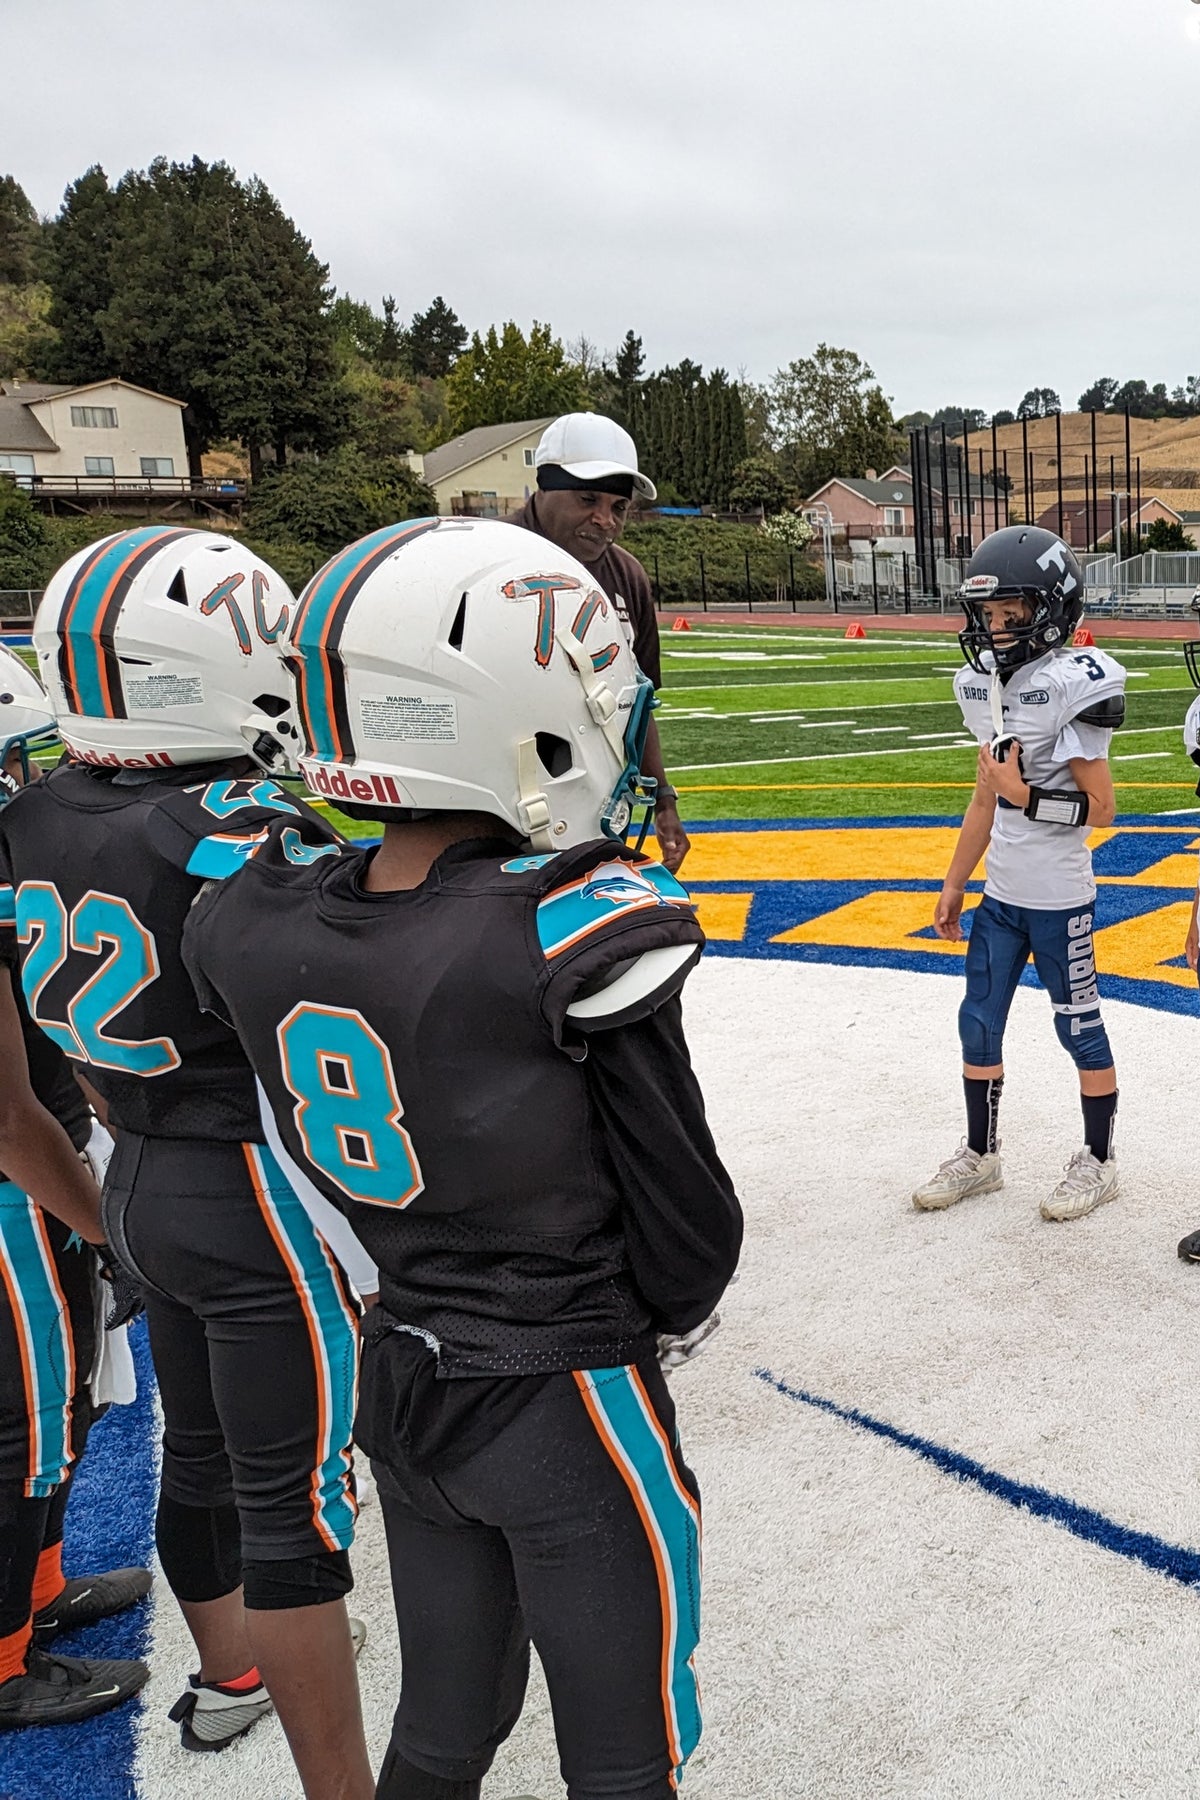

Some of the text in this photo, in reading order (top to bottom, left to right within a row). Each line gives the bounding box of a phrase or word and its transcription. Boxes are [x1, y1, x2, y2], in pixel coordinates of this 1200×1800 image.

[200, 570, 290, 656] TC
[500, 572, 620, 672] TC
[1075, 631, 1087, 644] 20
[963, 687, 988, 701] BIRDS
[1073, 654, 1105, 681] 3
[386, 695, 422, 704] WARNING
[15, 880, 182, 1078] 22
[276, 1000, 425, 1210] 8
